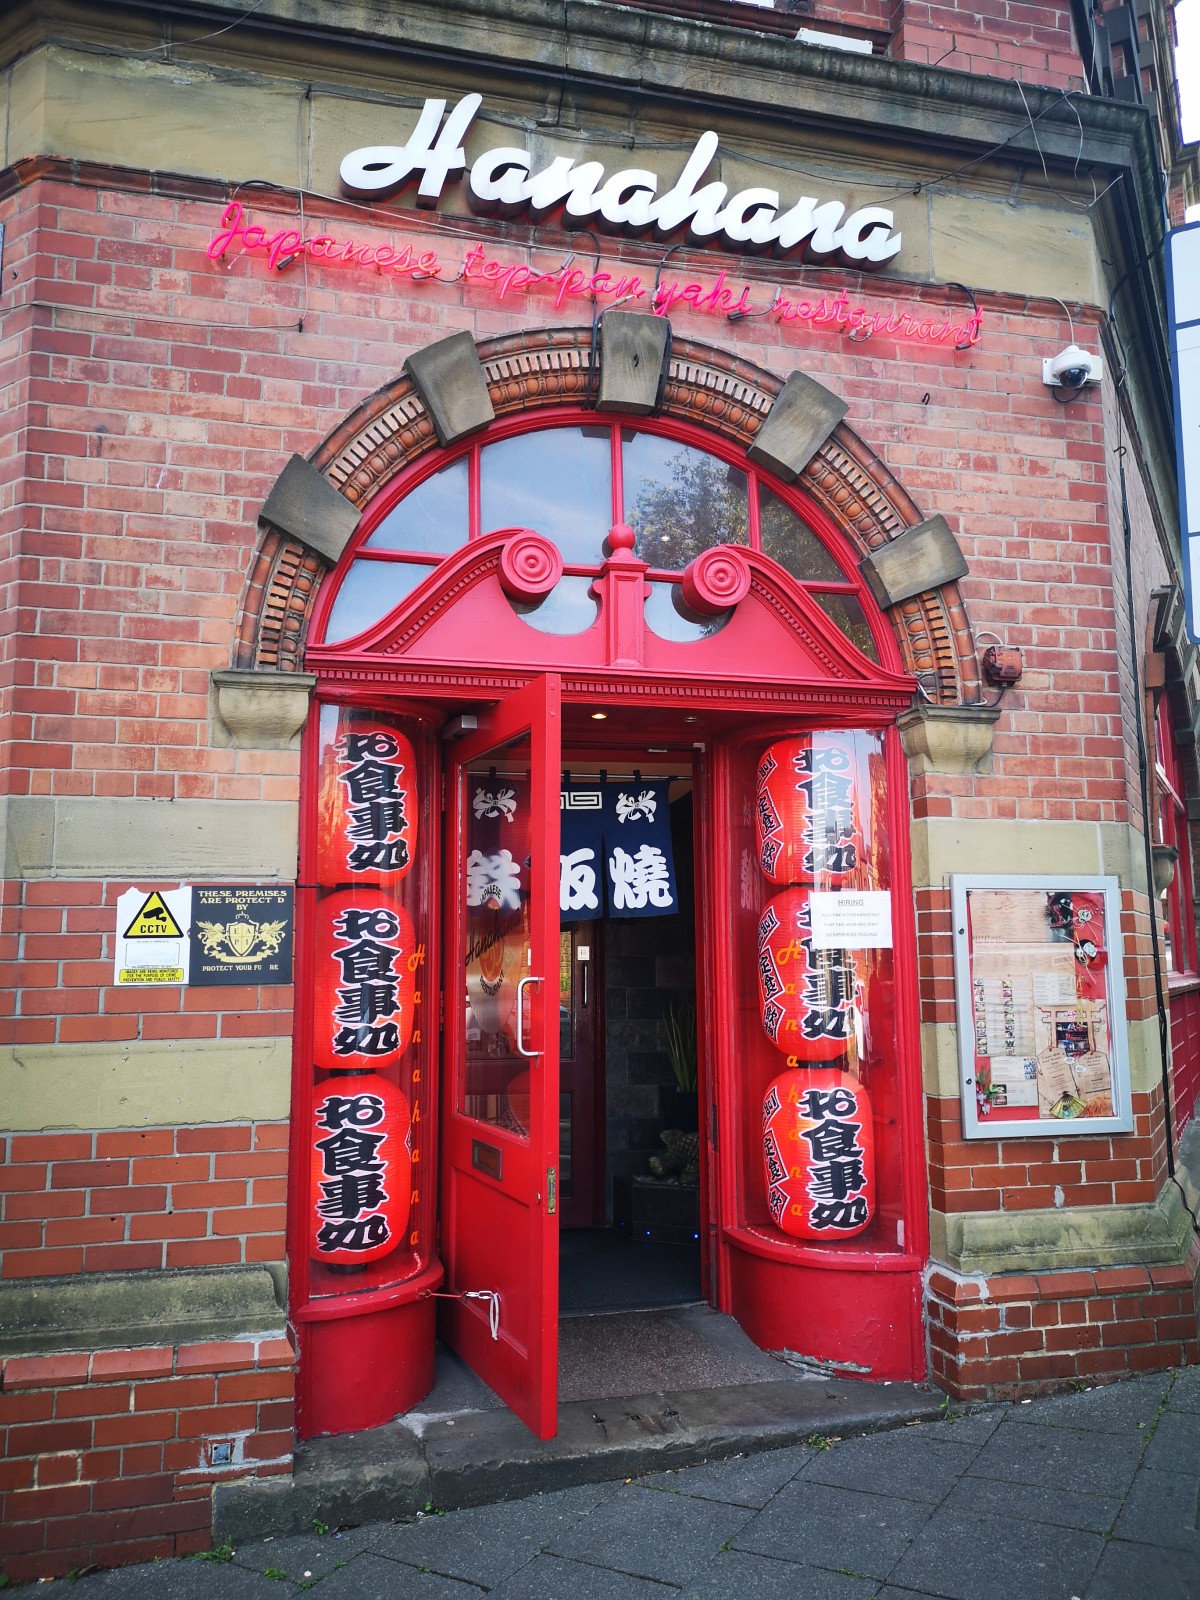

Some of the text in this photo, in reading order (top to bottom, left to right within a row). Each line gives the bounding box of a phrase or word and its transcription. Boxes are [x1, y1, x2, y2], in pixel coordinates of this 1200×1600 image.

[338, 92, 903, 262] Hanahana
[207, 201, 441, 273] Japanese
[652, 268, 753, 317] yaki
[772, 288, 984, 345] restaurant
[140, 924, 167, 934] CCTV
[837, 899, 865, 907] HIRING
